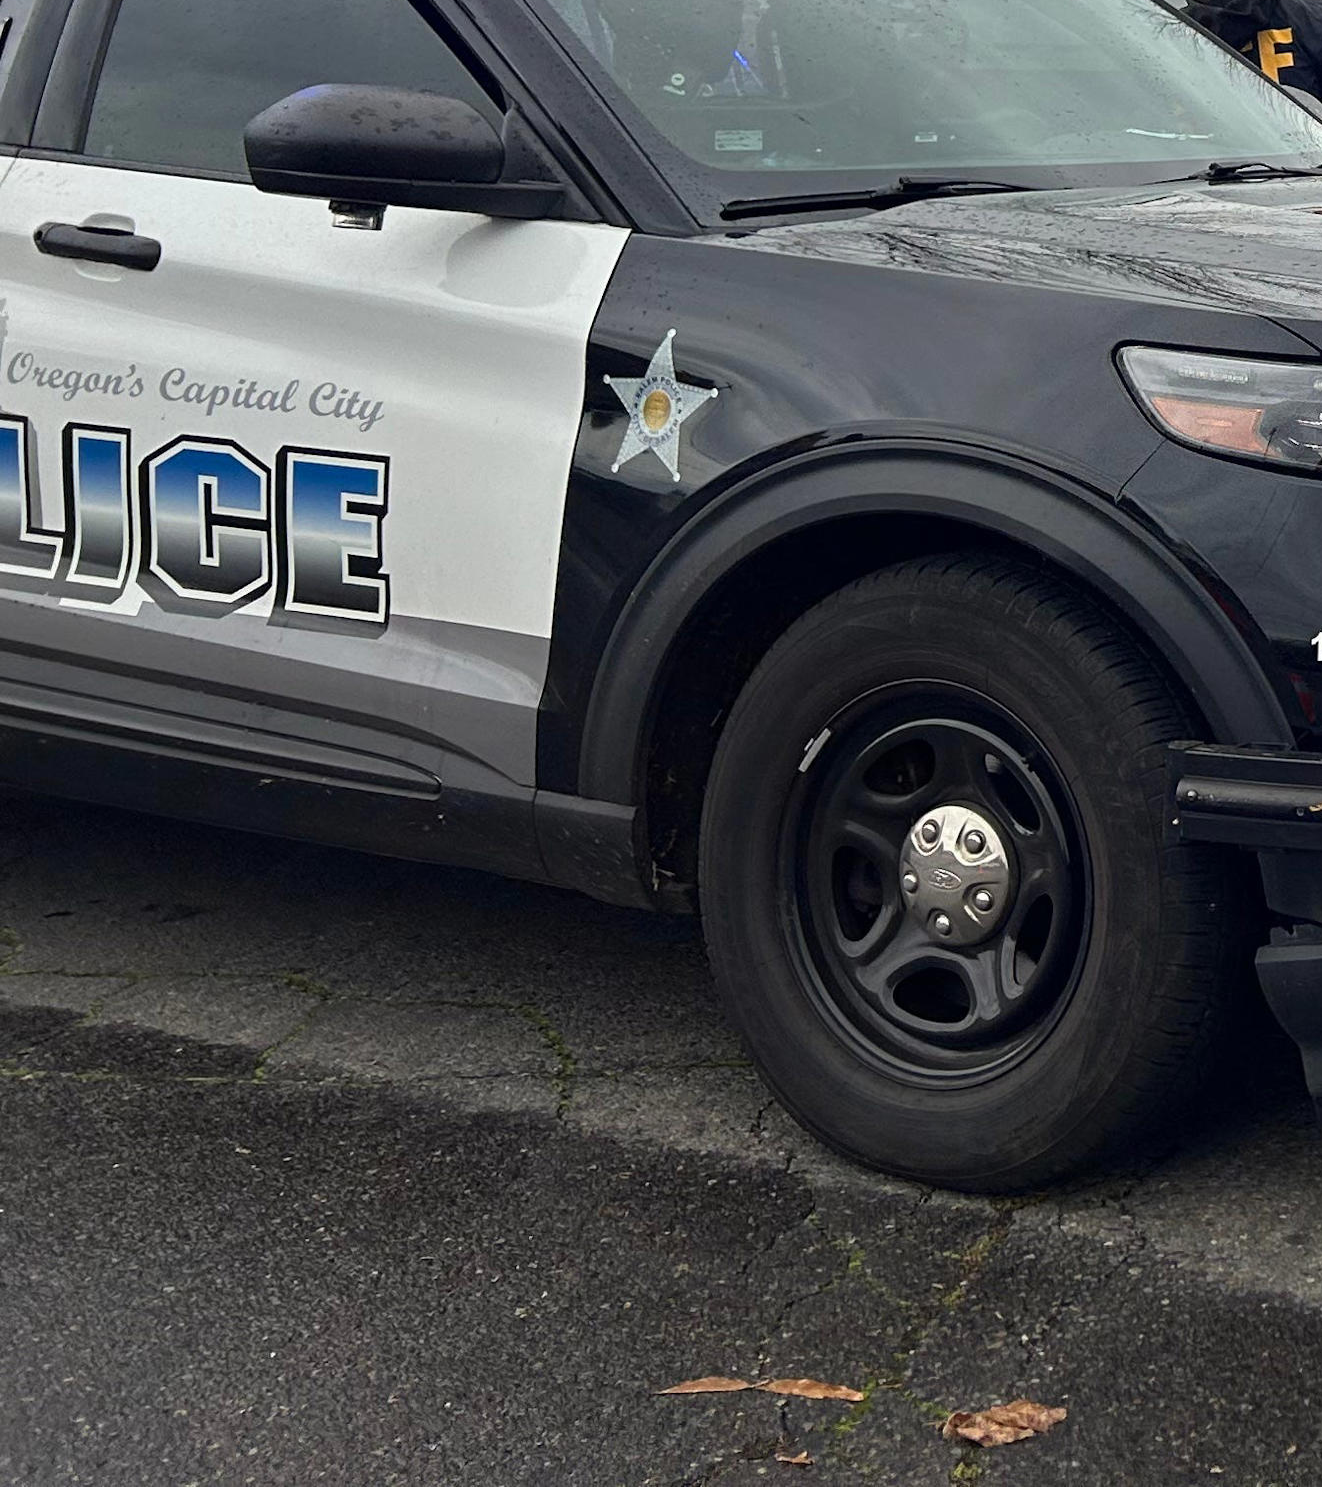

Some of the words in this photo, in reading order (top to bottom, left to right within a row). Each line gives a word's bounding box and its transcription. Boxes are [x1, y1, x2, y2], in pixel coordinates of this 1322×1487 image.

[1240, 17, 1295, 85] F
[7, 352, 144, 402] Oregon's
[159, 367, 300, 416] Capital
[308, 381, 385, 432] City
